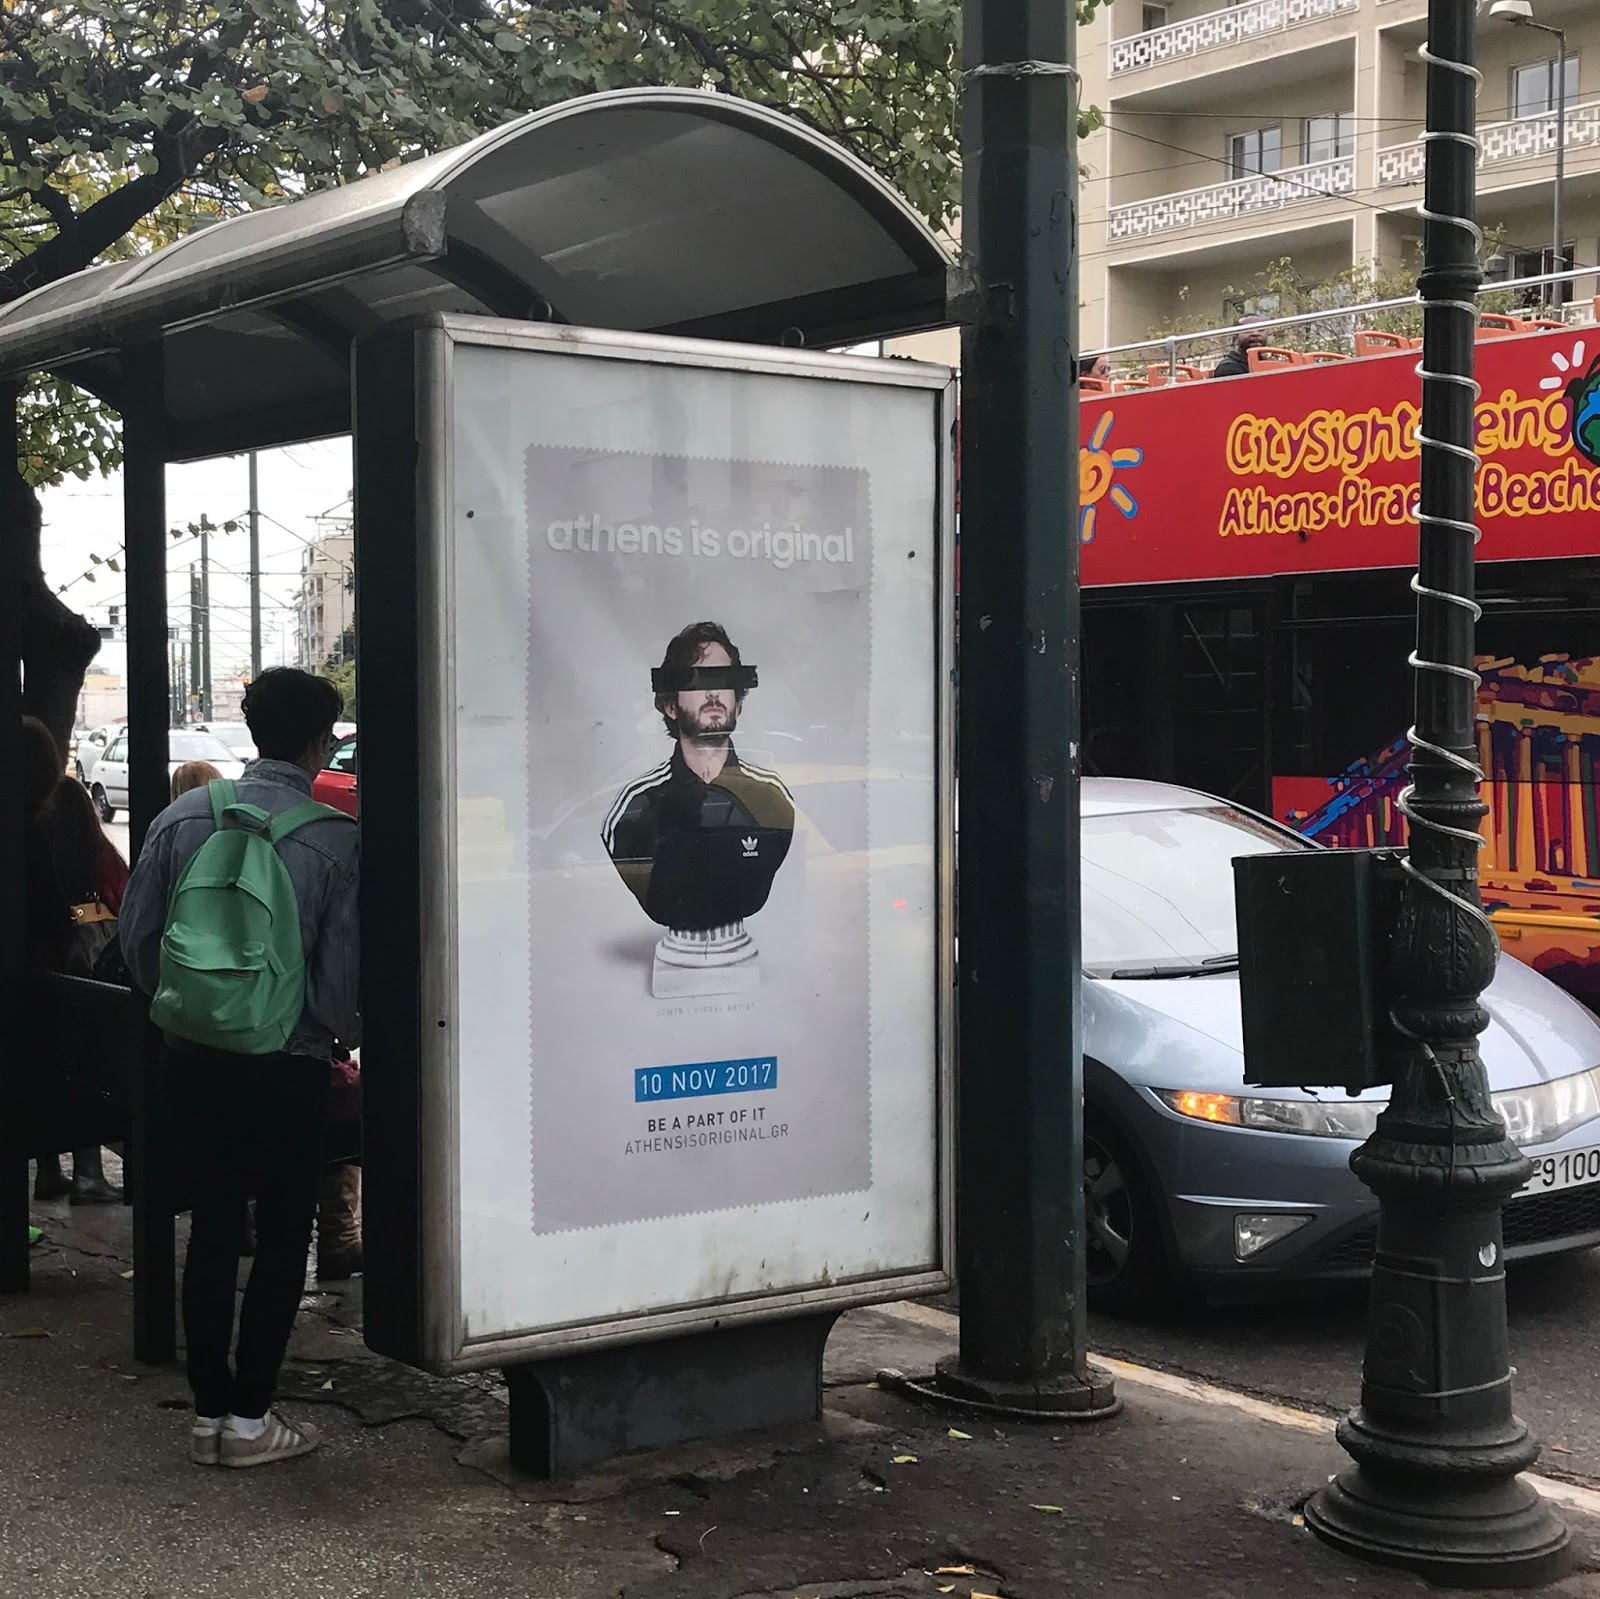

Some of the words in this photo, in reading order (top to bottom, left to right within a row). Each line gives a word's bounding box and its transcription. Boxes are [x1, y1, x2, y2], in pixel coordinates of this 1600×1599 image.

[1226, 389, 1574, 478] CitySighteing
[546, 513, 684, 556] athens
[691, 518, 721, 557] is
[726, 522, 854, 569] original
[641, 1074, 662, 1095] 10
[672, 1068, 716, 1092] NOV
[725, 1063, 772, 1087] 2017
[648, 1118, 666, 1132] BE
[672, 1116, 681, 1130] A
[687, 1112, 724, 1129] PART
[730, 1109, 747, 1123] OF
[753, 1107, 766, 1121] IT
[624, 1123, 789, 1156] ATHENSISORIGINAL.GR
